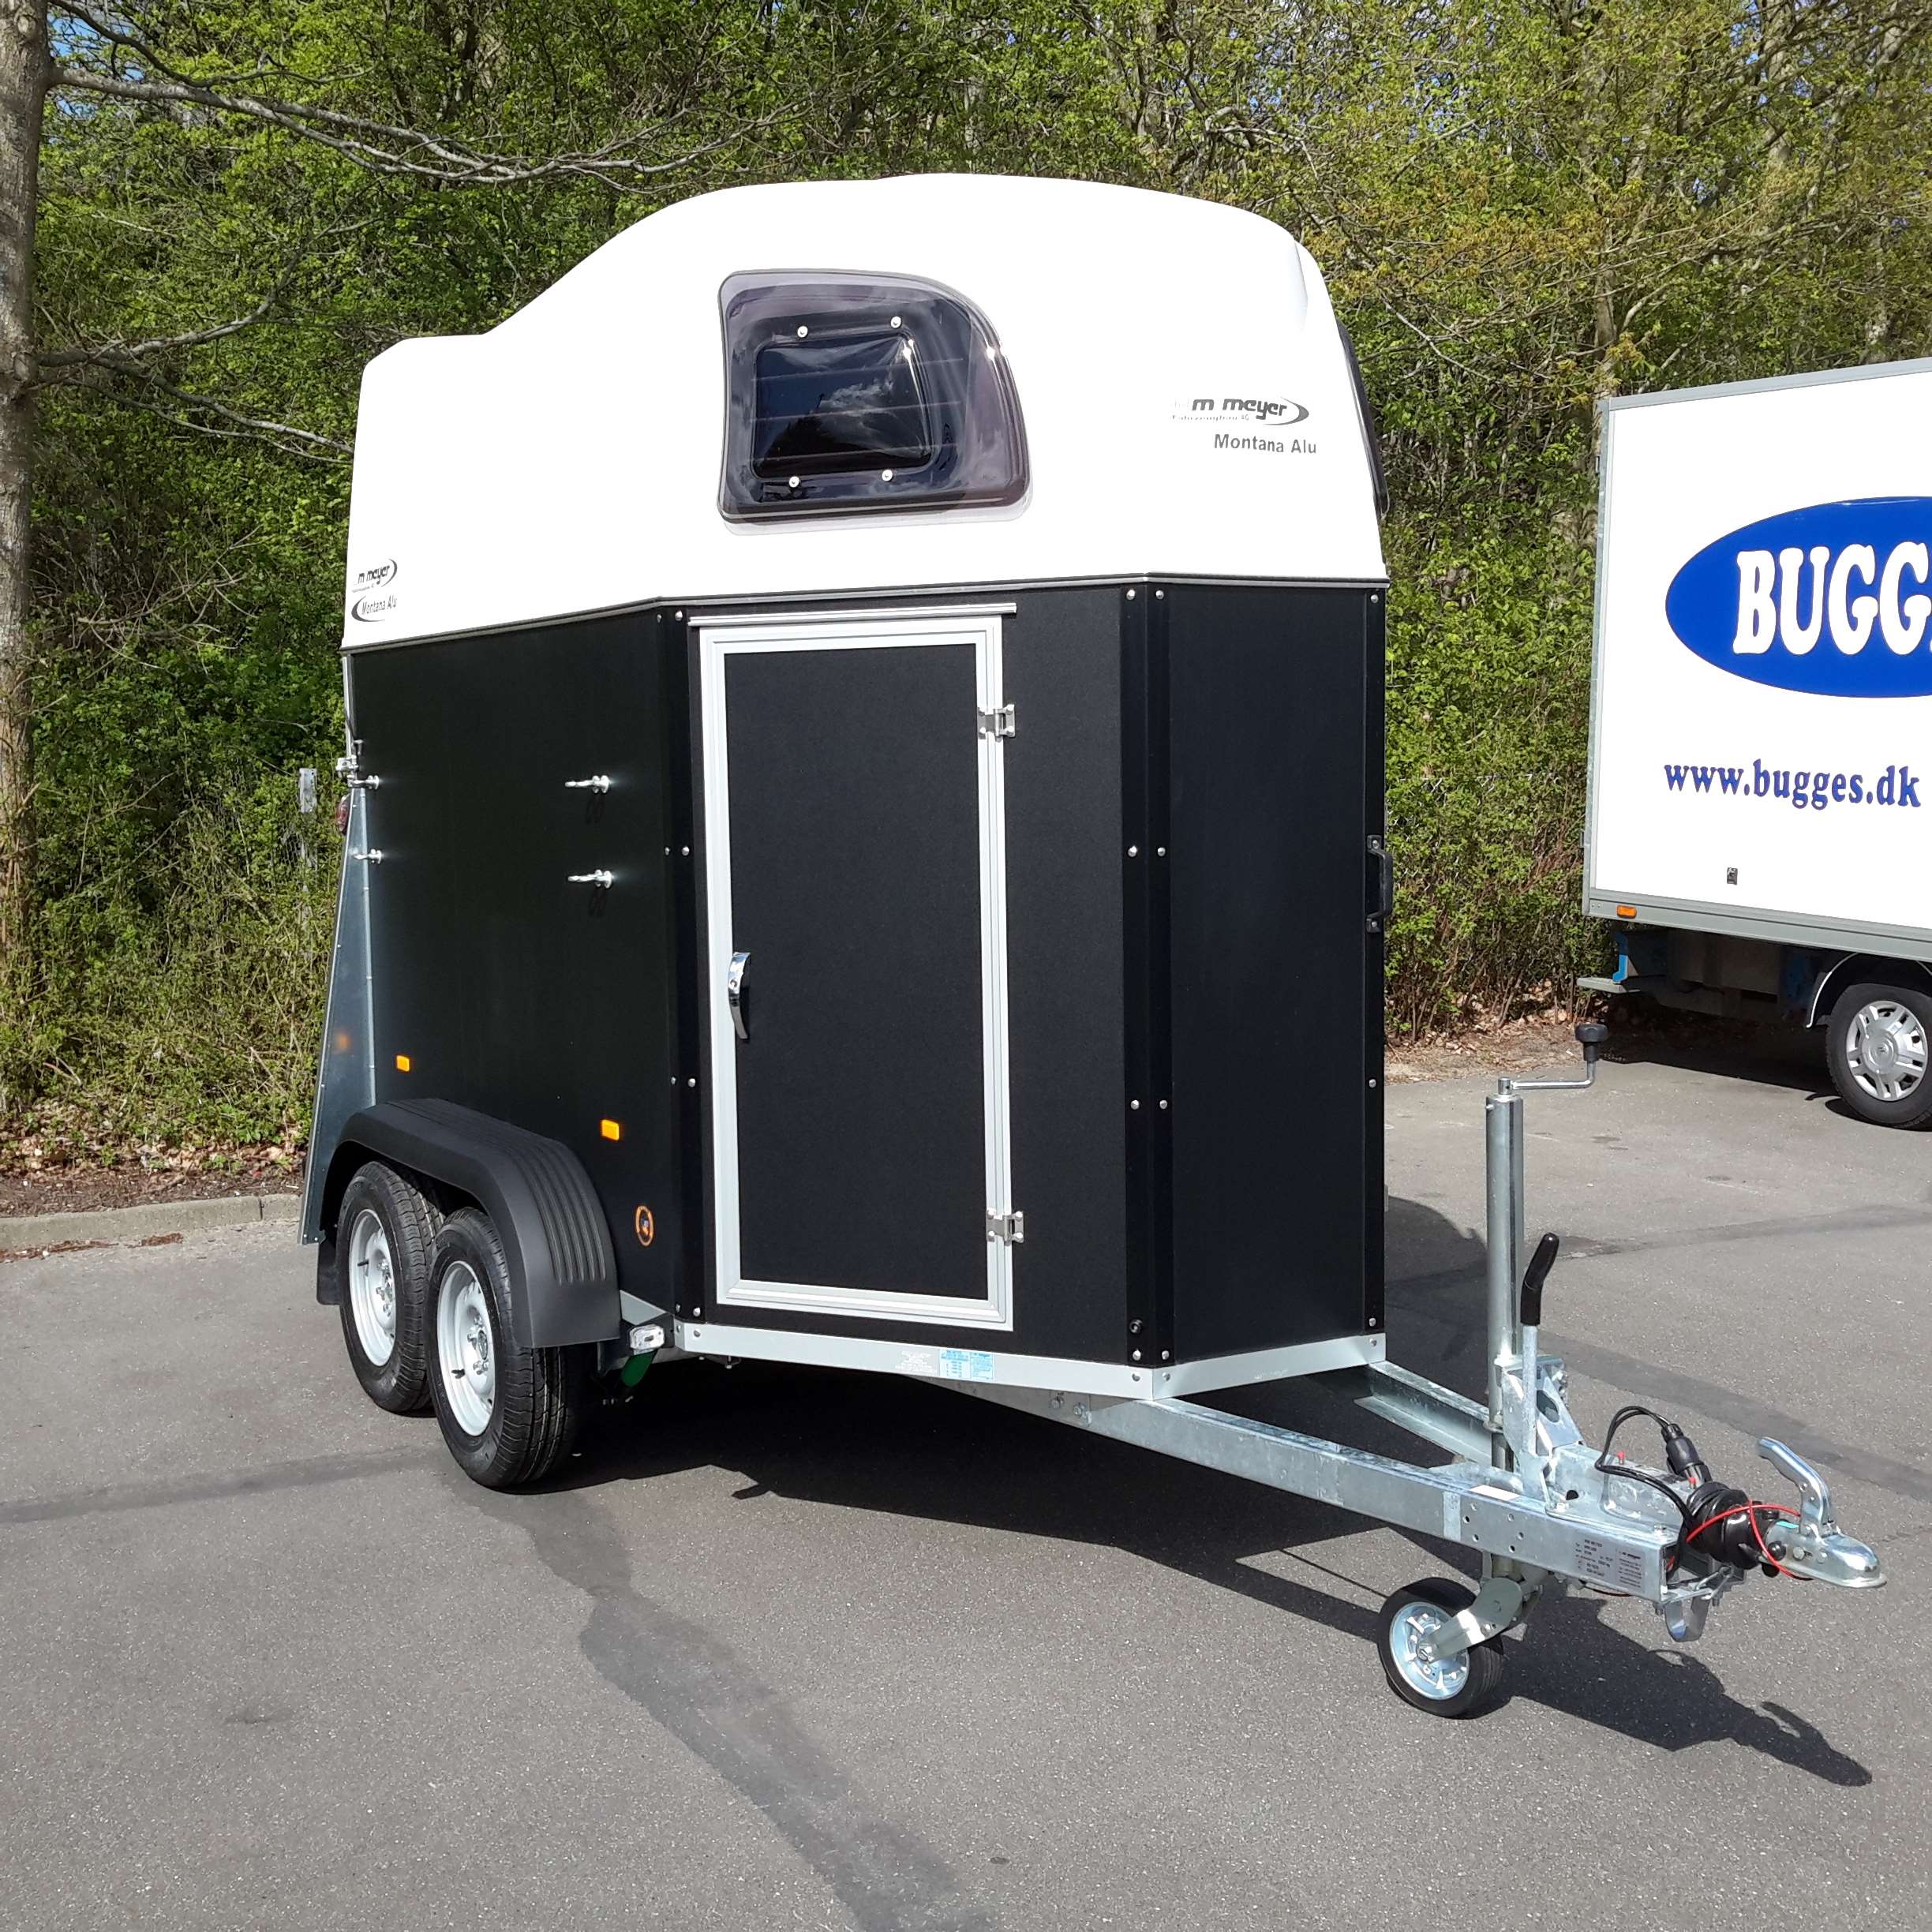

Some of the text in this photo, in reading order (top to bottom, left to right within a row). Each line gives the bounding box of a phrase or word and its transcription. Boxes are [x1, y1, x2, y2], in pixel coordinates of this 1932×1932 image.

[1222, 399, 1288, 420] meyer
[1214, 433, 1317, 454] Montana Alu
[362, 601, 385, 614] Montana
[1732, 541, 1932, 656] BUGG
[1664, 758, 1922, 811] www.bugges.dk
